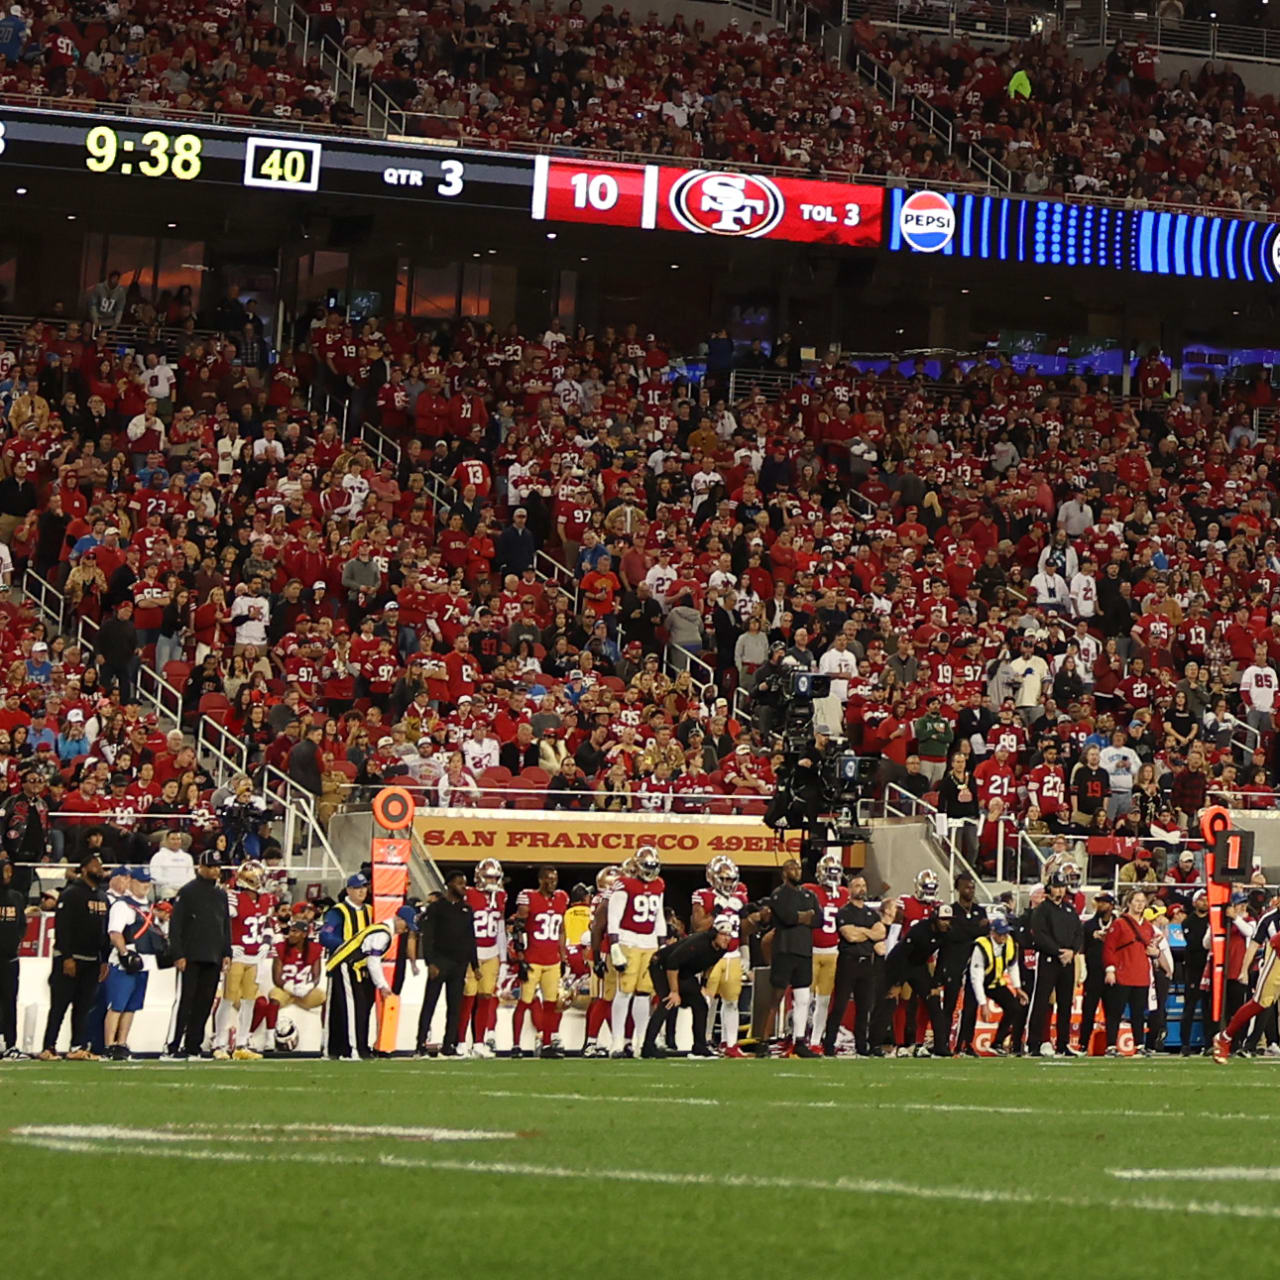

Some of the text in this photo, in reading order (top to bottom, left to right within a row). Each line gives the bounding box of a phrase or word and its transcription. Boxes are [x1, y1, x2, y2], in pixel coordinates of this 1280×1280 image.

[85, 127, 202, 180] 9:38
[260, 150, 305, 183] 40
[384, 160, 464, 196] QTR 3
[570, 172, 618, 210] 10
[802, 204, 860, 226] TOL 3
[904, 213, 950, 230] PEPSI
[343, 345, 354, 357] 19
[468, 466, 482, 483] 13
[574, 510, 589, 523] 97
[1191, 628, 1206, 644] 13
[299, 669, 312, 681] 97
[378, 668, 392, 680] 97
[938, 665, 951, 681] 19
[964, 665, 981, 679] 97
[1255, 674, 1272, 688] 85
[1132, 684, 1147, 697] 23
[999, 734, 1017, 751] 99
[990, 775, 1009, 795] 21
[1043, 777, 1061, 796] 23
[424, 830, 496, 846] SAN
[506, 832, 698, 850] FRANCISCO
[1227, 836, 1240, 869] 1
[633, 894, 663, 922] 99
[473, 910, 499, 935] 26
[534, 913, 563, 940] 30
[281, 966, 312, 983] 24
[1117, 1032, 1134, 1054] G
